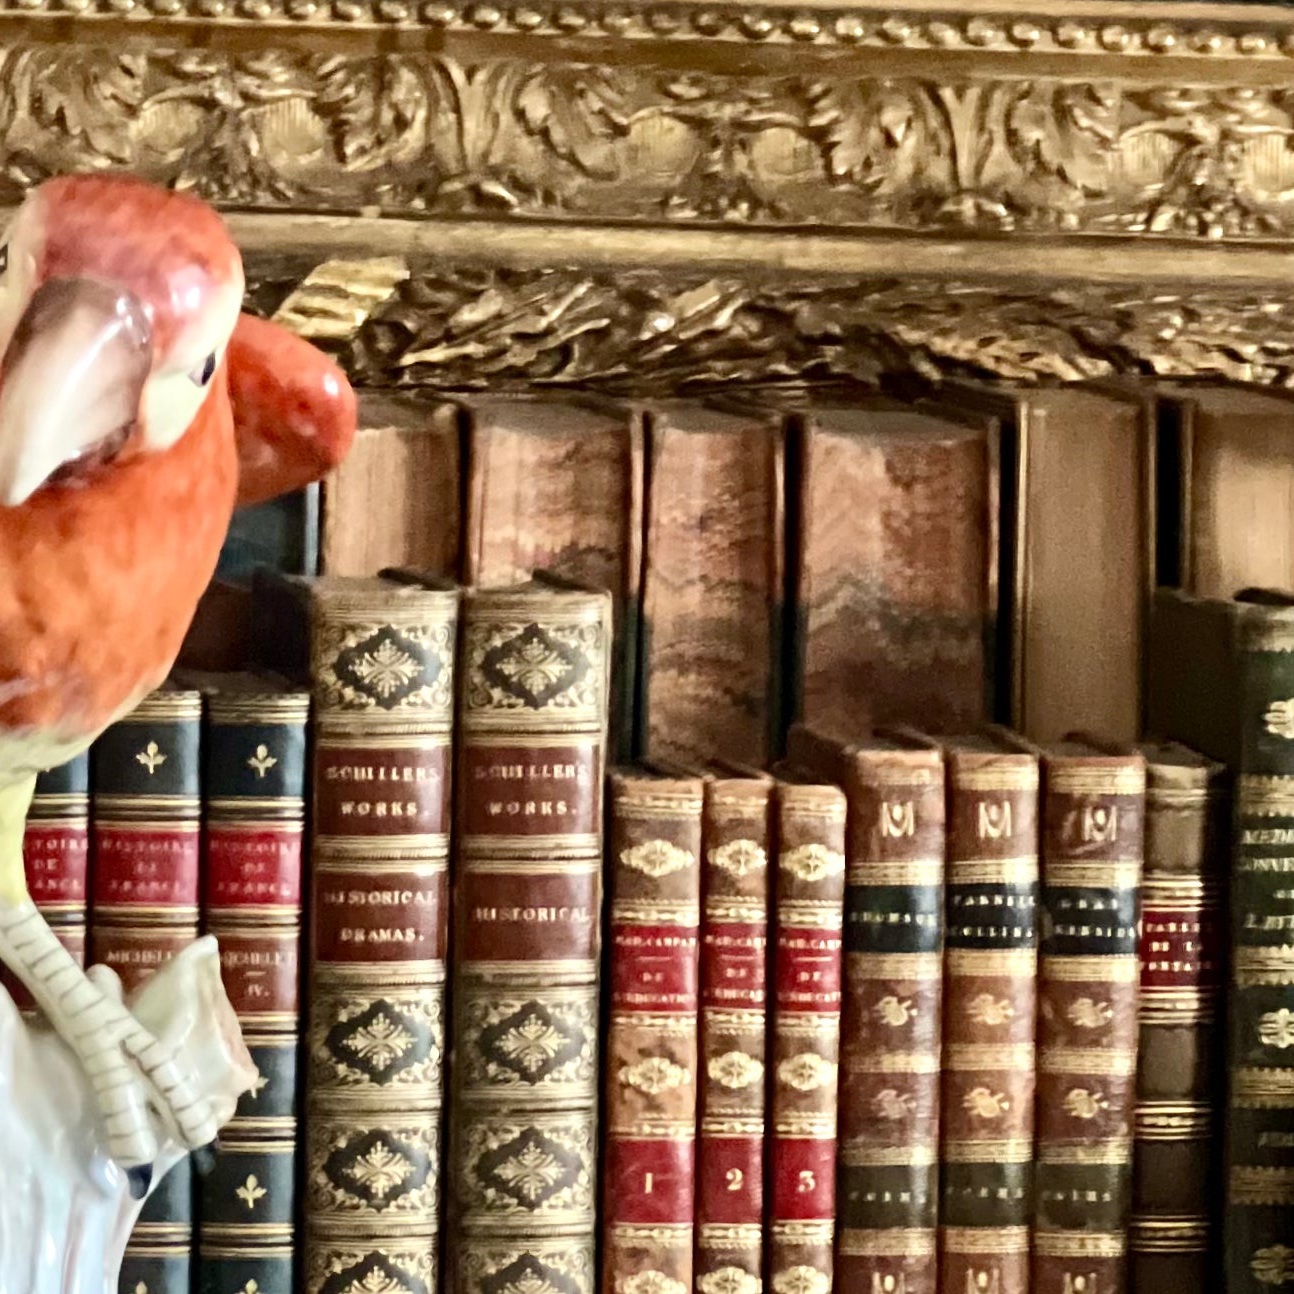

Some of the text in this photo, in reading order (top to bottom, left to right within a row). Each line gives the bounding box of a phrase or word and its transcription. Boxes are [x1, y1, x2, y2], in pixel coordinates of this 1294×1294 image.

[341, 801, 429, 817] WORKS.
[489, 801, 577, 816] WORKS.
[324, 890, 437, 905] HISTORICAL
[475, 907, 590, 922] HISTORICAL
[341, 927, 425, 942] DRAMAS.
[726, 1168, 744, 1192] 2
